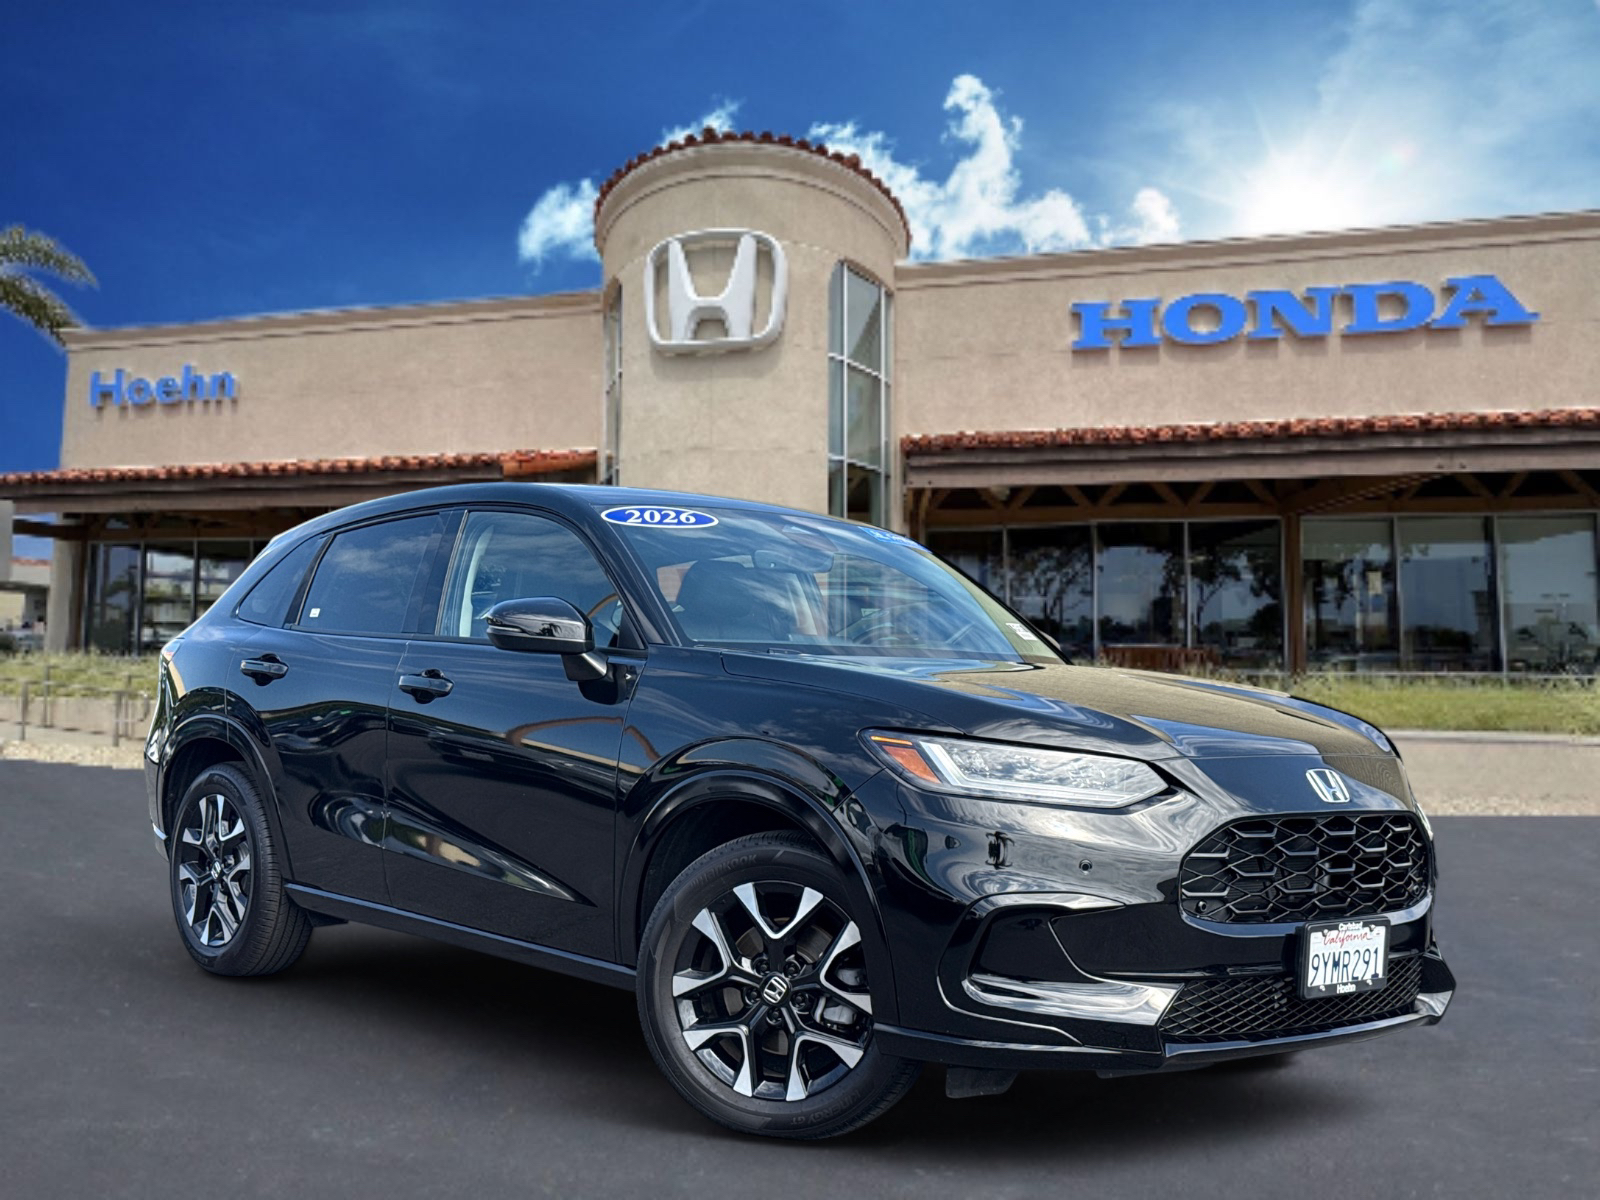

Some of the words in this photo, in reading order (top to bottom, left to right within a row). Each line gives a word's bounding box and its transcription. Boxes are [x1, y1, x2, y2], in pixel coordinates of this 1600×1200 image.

[1071, 275, 1539, 350] HONDA
[90, 364, 236, 406] Hoehn
[625, 509, 697, 523] 2026
[1324, 930, 1373, 948] California
[1309, 947, 1379, 986] 9YMR291
[1336, 983, 1356, 994] Hoehn
